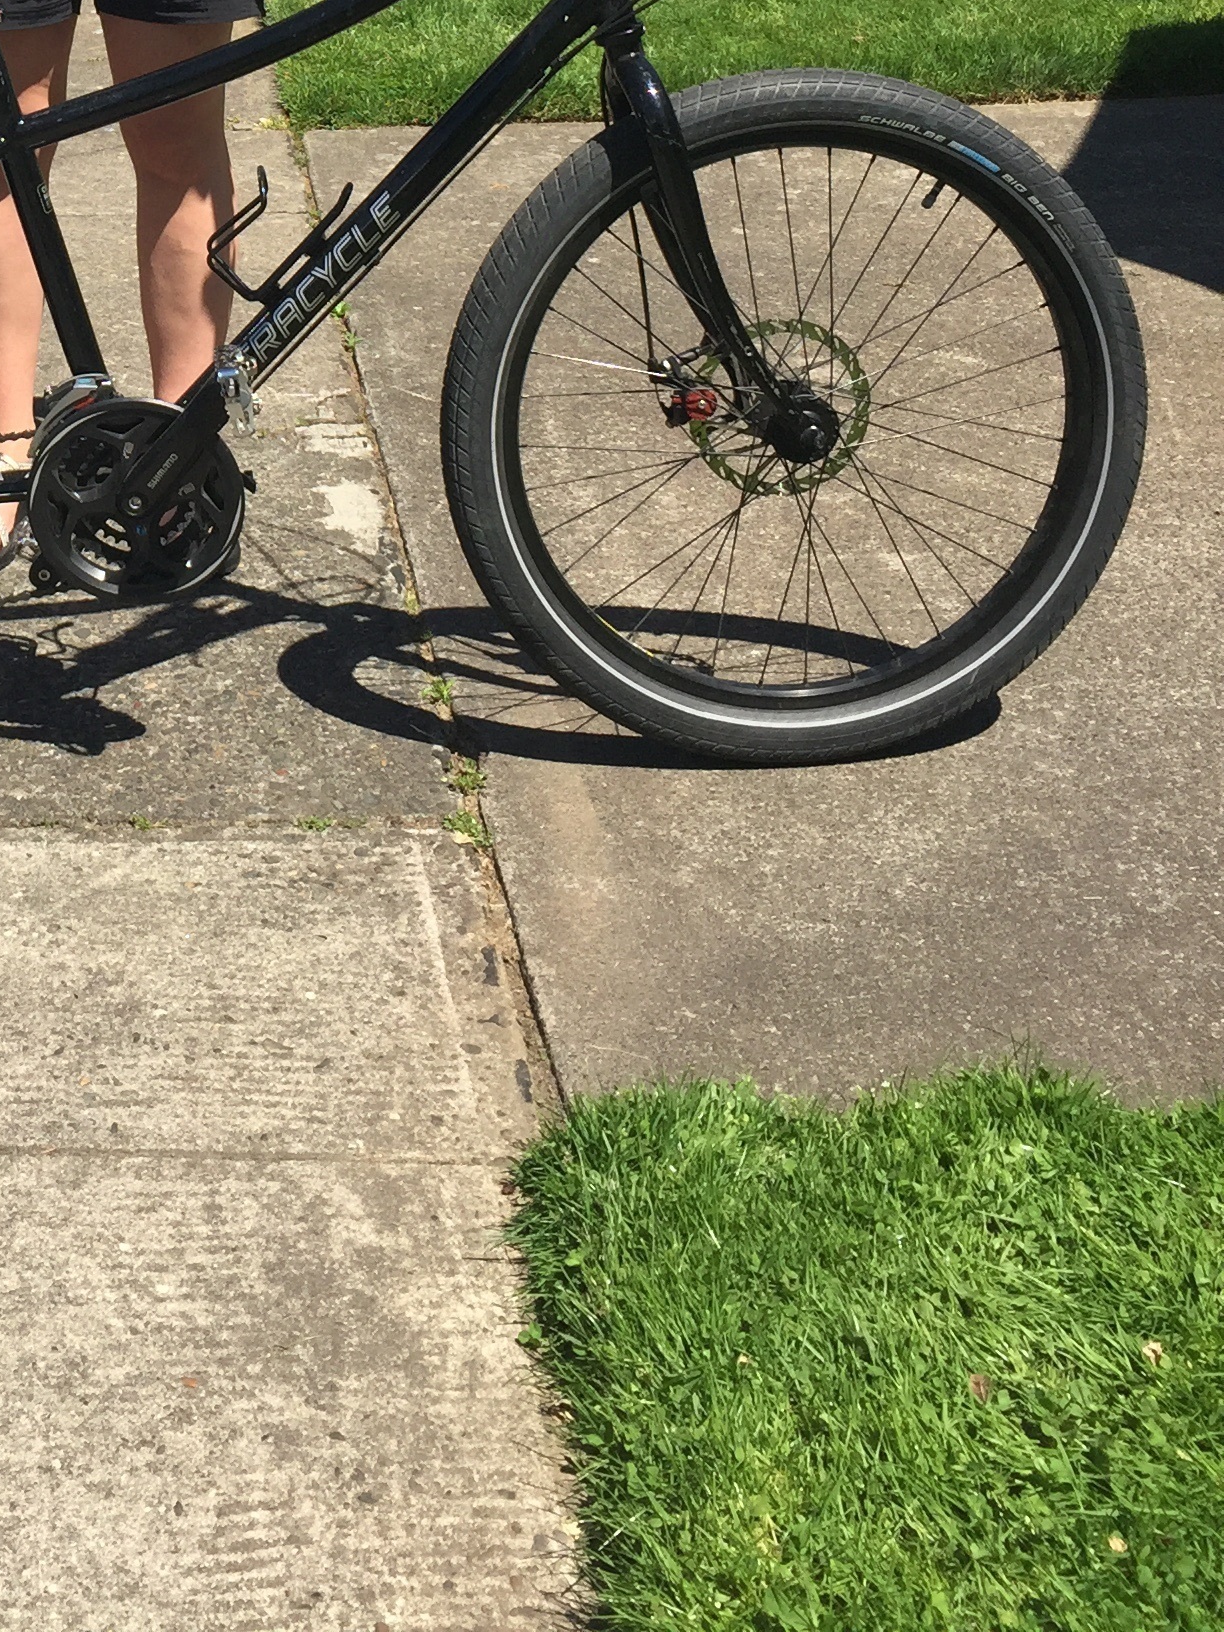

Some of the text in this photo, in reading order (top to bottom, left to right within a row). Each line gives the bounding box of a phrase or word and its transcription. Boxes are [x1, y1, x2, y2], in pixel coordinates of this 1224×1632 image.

[857, 115, 947, 143] SCHWALBE
[1001, 173, 1028, 193] BIG
[240, 190, 401, 364] RACYCLE
[147, 452, 179, 490] SHIMANO
